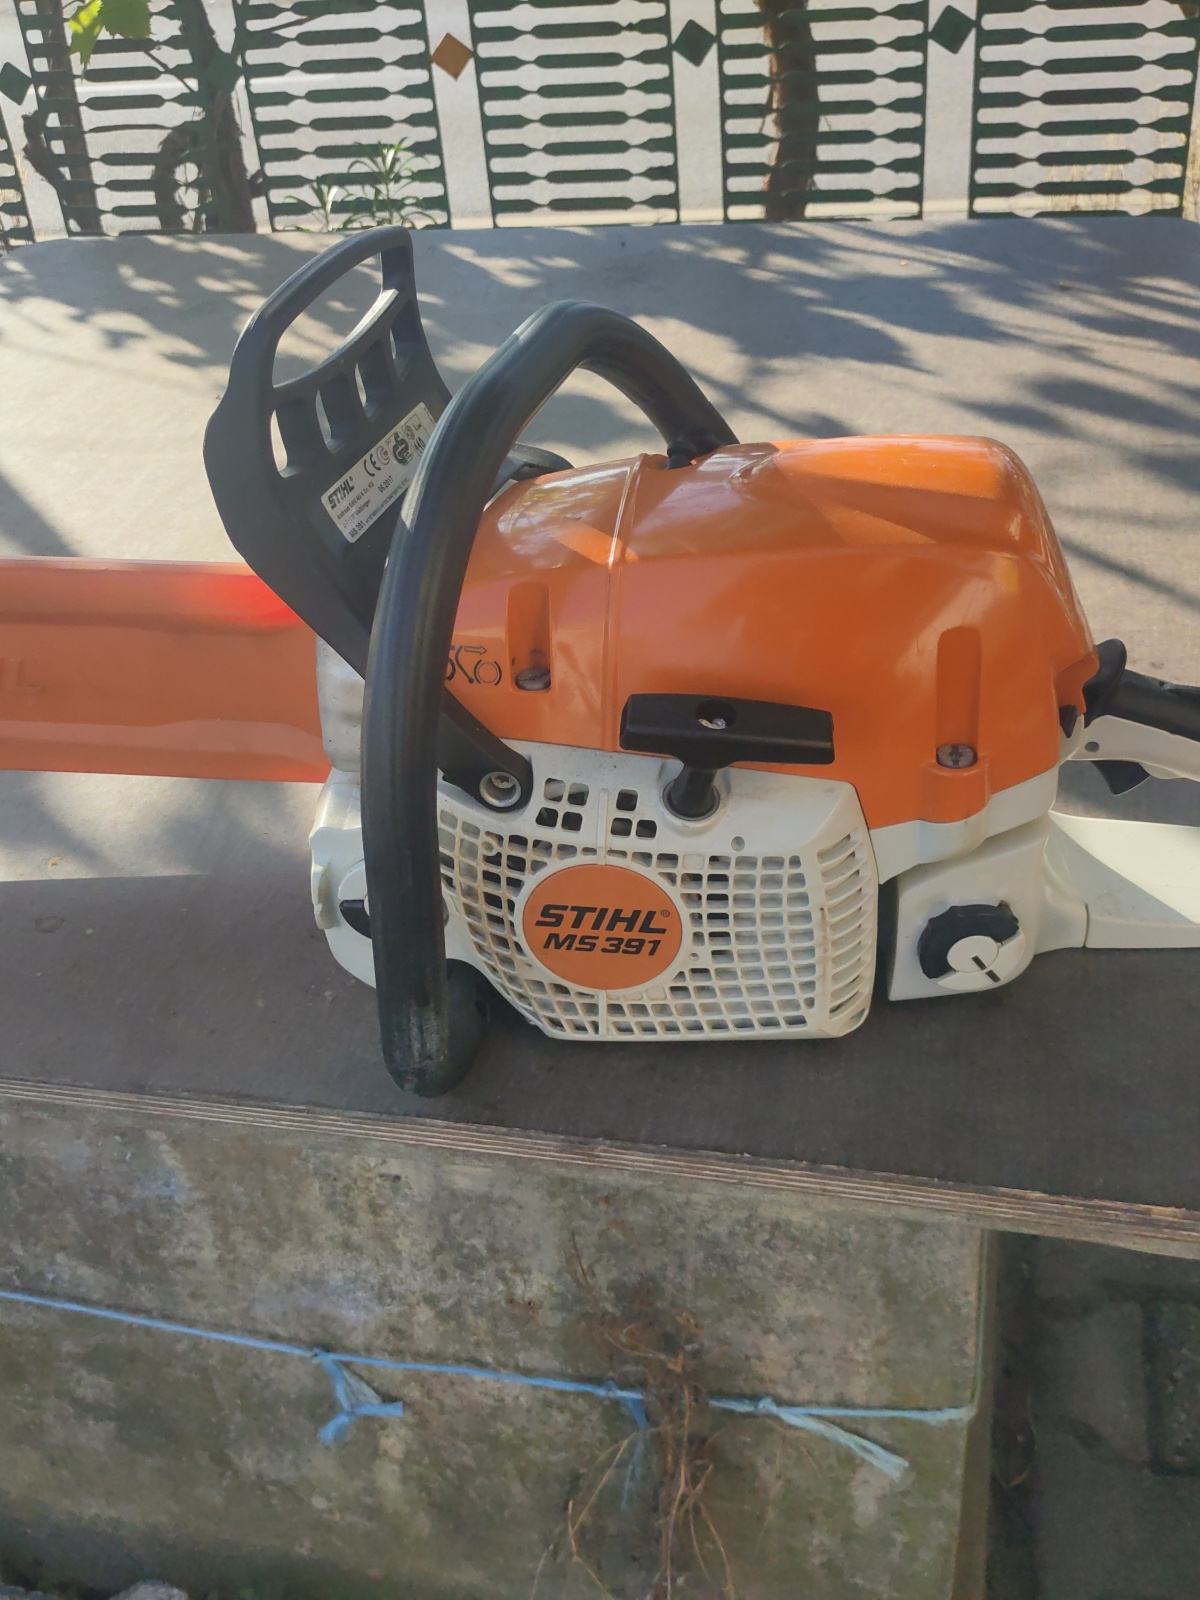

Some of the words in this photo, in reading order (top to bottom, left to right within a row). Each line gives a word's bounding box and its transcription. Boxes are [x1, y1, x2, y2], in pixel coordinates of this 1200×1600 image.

[327, 478, 355, 510] STIHL
[535, 903, 667, 934] STIHL
[543, 932, 599, 952] MS
[600, 936, 662, 956] 391
